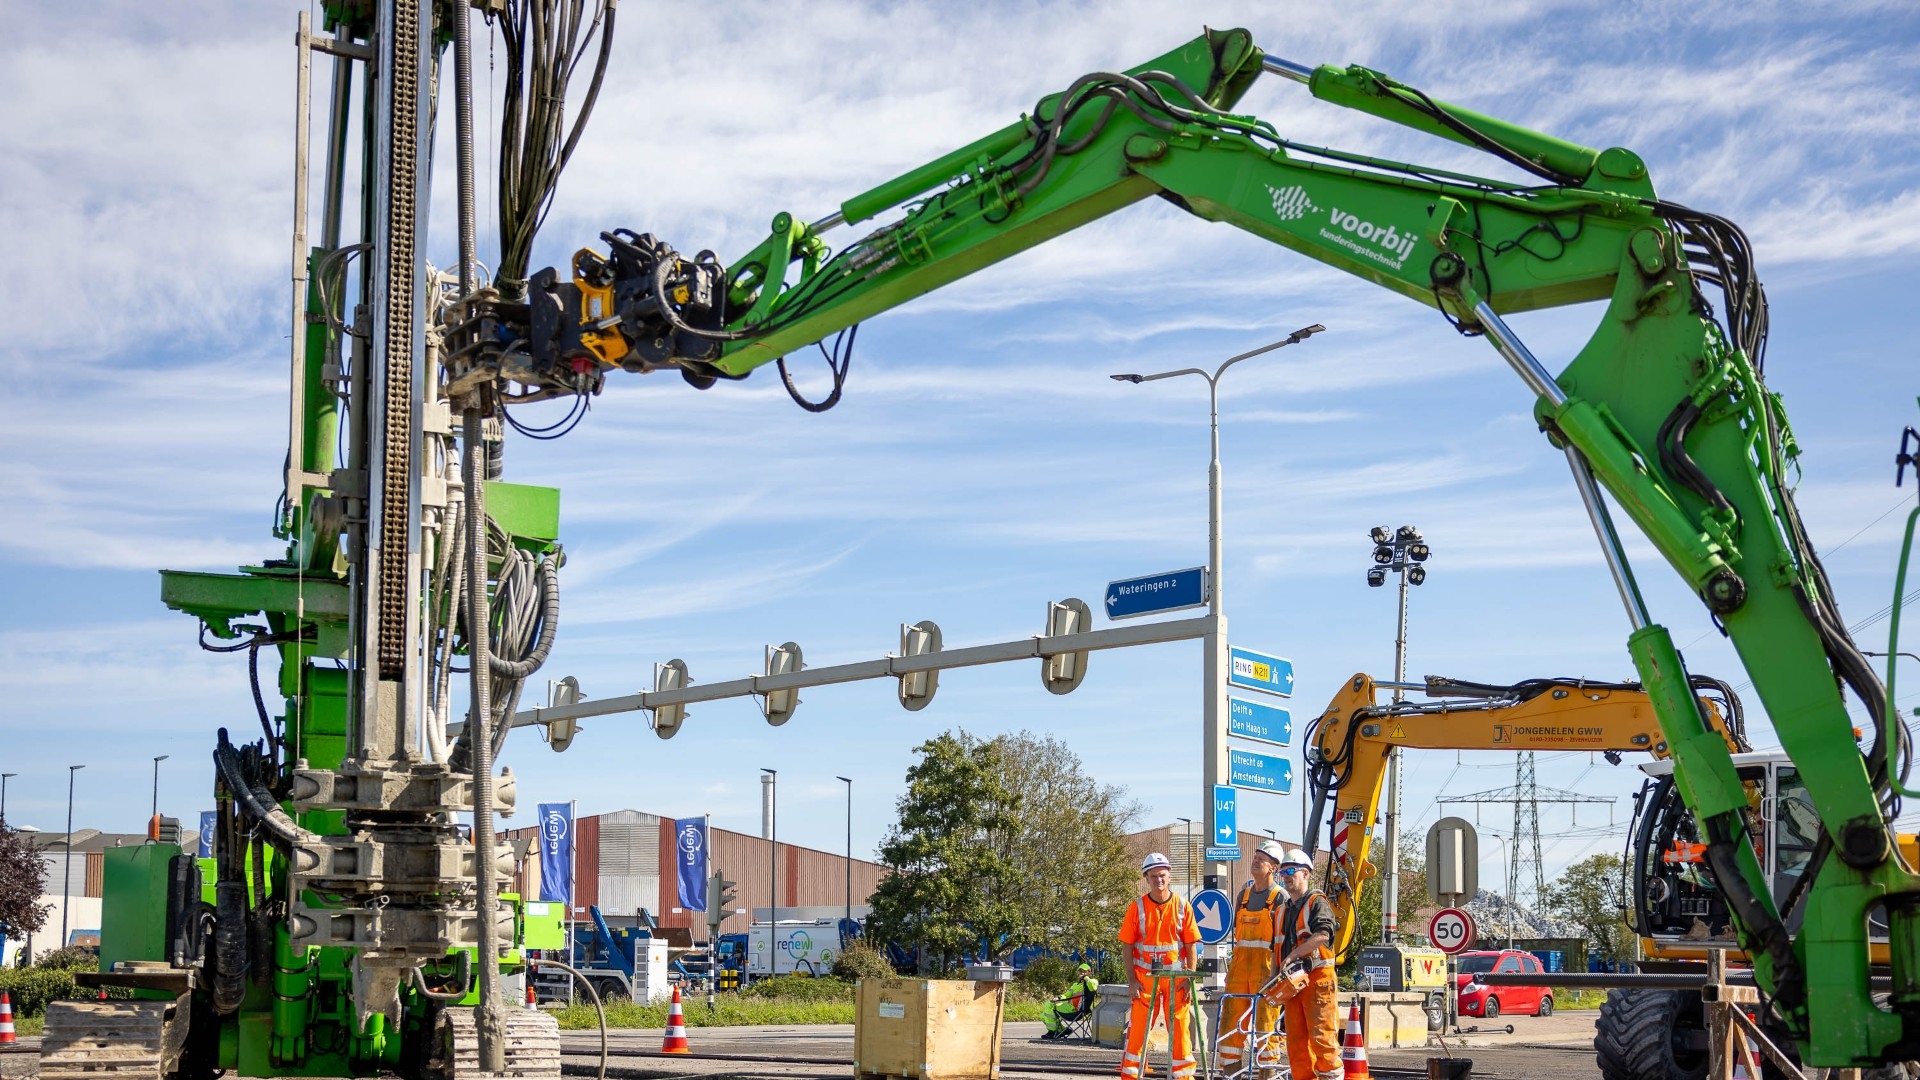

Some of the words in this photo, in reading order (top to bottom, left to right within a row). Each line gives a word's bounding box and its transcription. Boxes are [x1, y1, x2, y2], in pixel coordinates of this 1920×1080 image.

[1330, 207, 1418, 262] voorbij
[1319, 228, 1402, 270] funderingstechniek
[1119, 581, 1169, 595] Wateringen
[1171, 580, 1177, 588] 2
[1235, 661, 1252, 674] RING
[1254, 665, 1269, 678] N211
[1232, 703, 1248, 716] Delft
[1232, 719, 1244, 730] Den
[1246, 722, 1261, 736] Haag
[1513, 727, 1574, 735] JONGENELEN
[1578, 727, 1603, 735] GWW
[1232, 754, 1256, 767] Utrecht
[1257, 760, 1263, 768] 65
[1232, 770, 1266, 785] Amsterdam
[1437, 922, 1463, 940] 50
[777, 939, 813, 950] renewi
